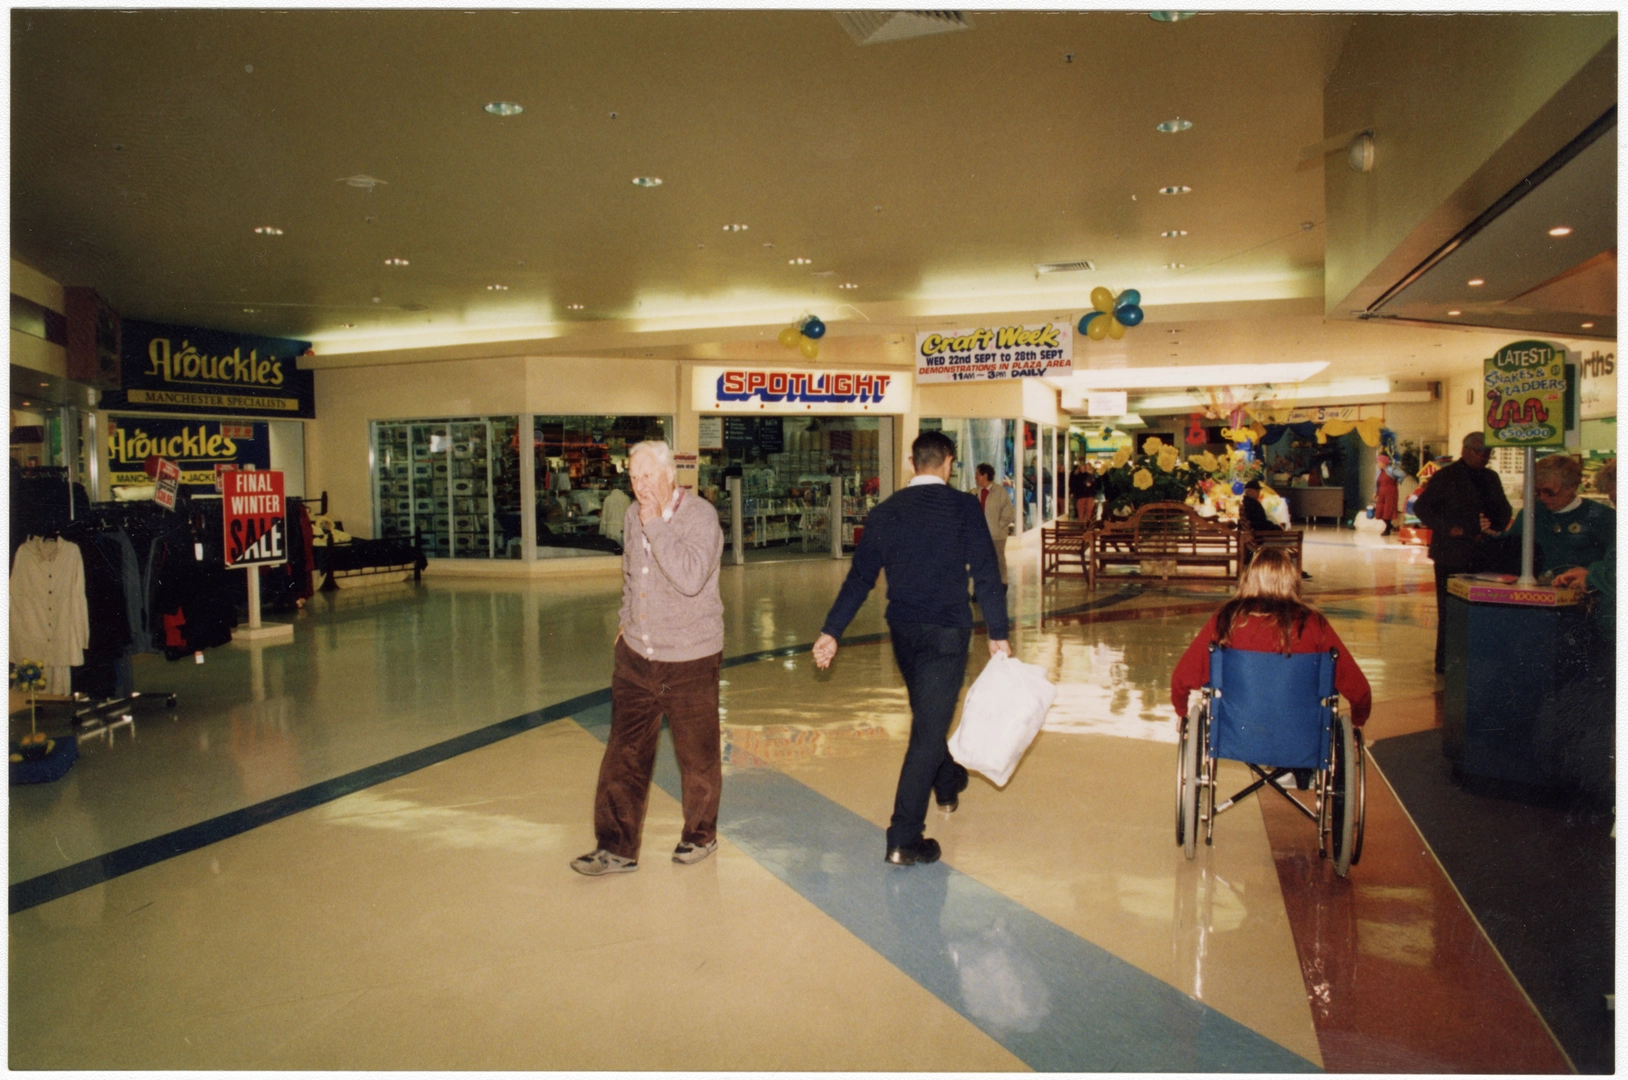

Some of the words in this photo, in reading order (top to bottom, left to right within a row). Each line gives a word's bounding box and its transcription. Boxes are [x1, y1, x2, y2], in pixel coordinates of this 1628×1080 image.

[921, 328, 995, 356] Craft
[996, 323, 1060, 349] Week
[144, 337, 284, 386] Arbuckle's
[926, 357, 945, 366] WED
[949, 354, 971, 365] 22nd
[975, 353, 997, 363] SEPT
[1001, 353, 1011, 362] to
[1015, 351, 1037, 361] 28th
[1040, 350, 1064, 359] SEPT
[1497, 347, 1552, 366] LATEST!
[919, 364, 997, 375] DEMONSTRATIONS
[1012, 361, 1042, 369] PLAZA
[1046, 359, 1072, 368] AREA
[987, 371, 1007, 379] 3PM
[1011, 368, 1047, 378] DAILY
[717, 371, 891, 403] SPOTLIGHT
[1485, 369, 1534, 389] SNAKES
[1535, 368, 1545, 377] &
[1504, 378, 1567, 397] LADDERS
[146, 391, 224, 406] MANCHESTER
[227, 397, 286, 408] SPECIALISTS
[1499, 427, 1551, 439] $50,000
[117, 473, 156, 484] MANCHE
[188, 473, 216, 483] JACKE
[236, 473, 273, 493] FINAL
[231, 494, 280, 515] WINTER
[230, 516, 283, 561] SALE
